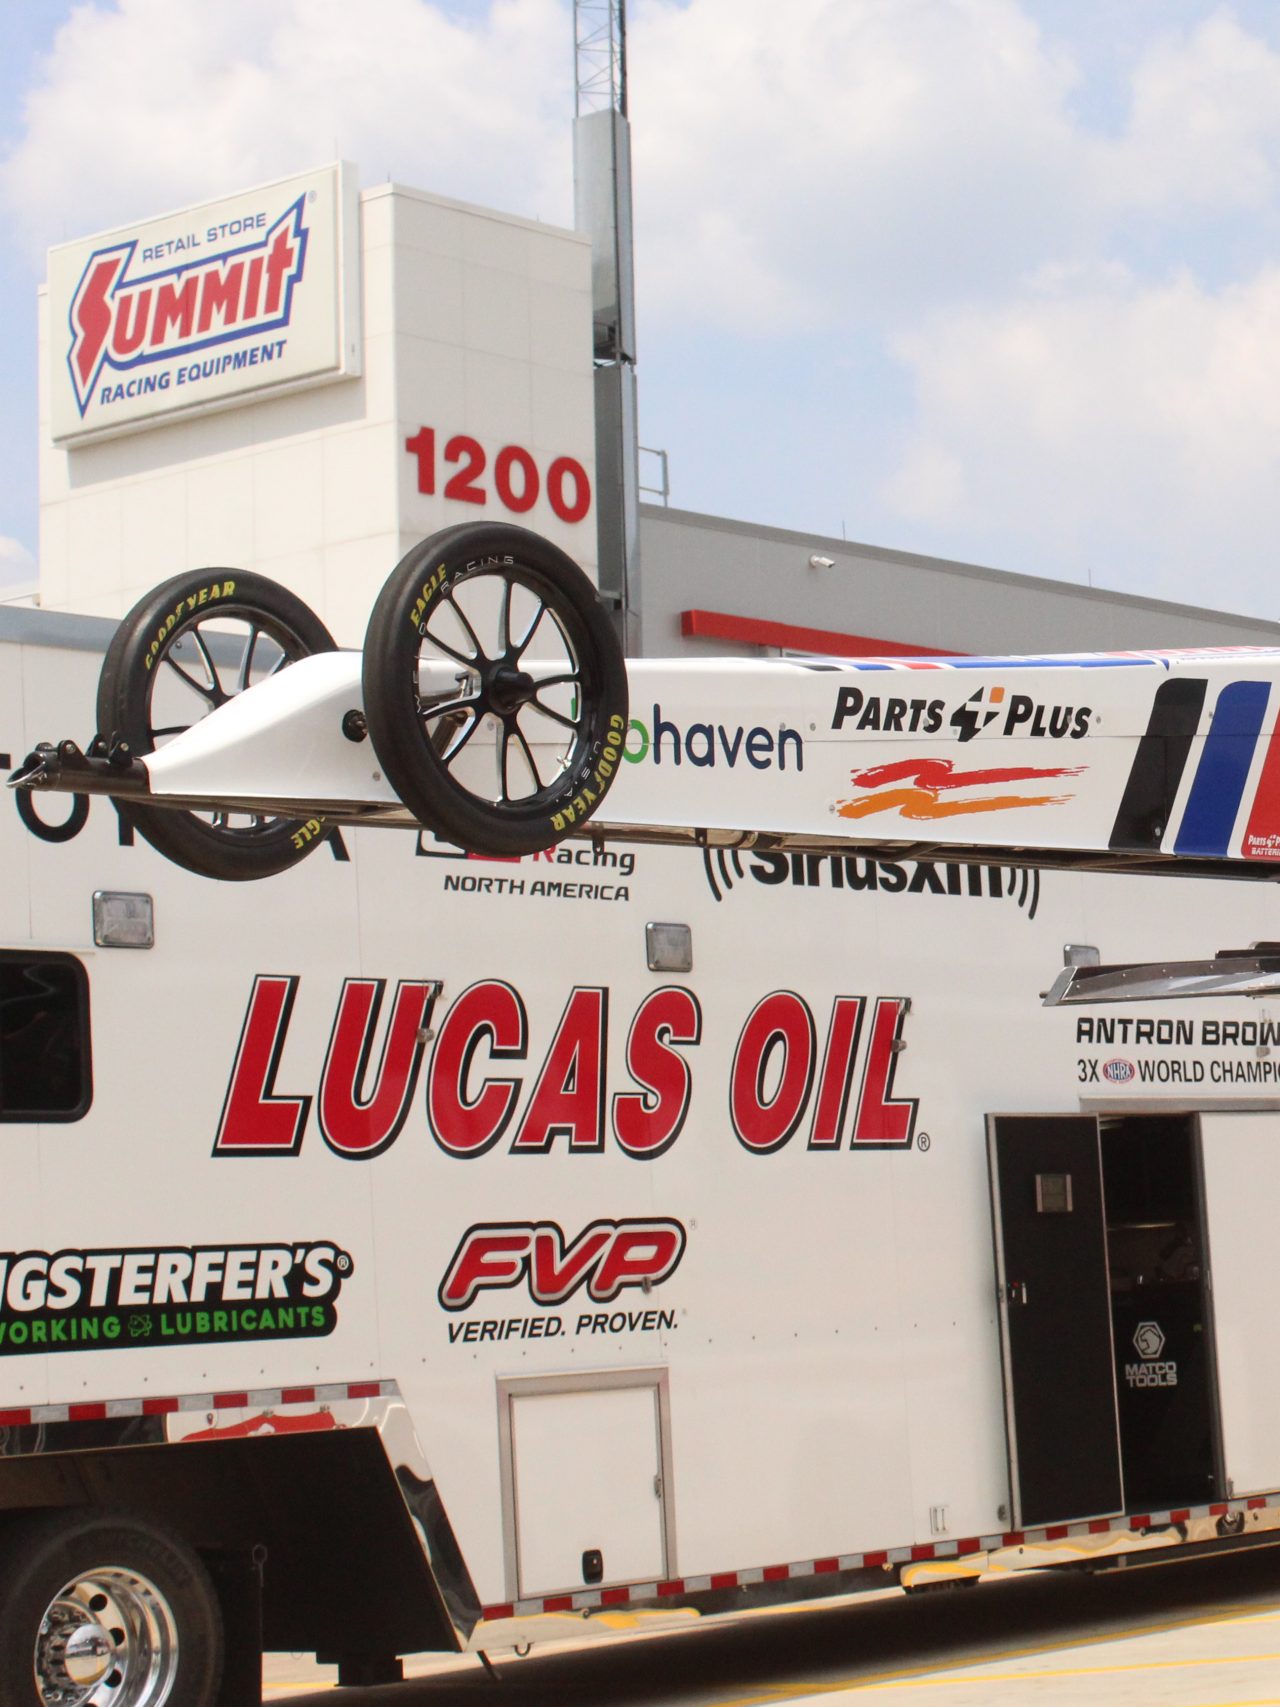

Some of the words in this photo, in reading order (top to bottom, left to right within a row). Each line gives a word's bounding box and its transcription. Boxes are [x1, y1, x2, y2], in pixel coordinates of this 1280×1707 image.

[142, 234, 201, 263] RETAIL
[206, 212, 267, 243] STORE
[76, 224, 295, 388] SUMMIT
[100, 371, 171, 405] RACING
[176, 339, 288, 386] EQUIPMENT
[405, 426, 592, 524] 1200
[410, 562, 448, 627] EAGLE
[145, 580, 236, 671] GOODYEAR
[621, 703, 804, 772] ohaven
[831, 686, 945, 733] PARTS
[1002, 694, 1092, 740] PLUS
[550, 714, 625, 831] GOODYEAR
[1248, 834, 1267, 847] PARTS
[444, 874, 525, 896] NORTH
[530, 880, 630, 901] AMERICA
[1076, 1017, 1194, 1046] ANTRON
[211, 973, 701, 1161] LUCAS
[730, 989, 920, 1155] OIL
[1077, 1058, 1101, 1083] 3X
[1104, 1060, 1135, 1083] NHRA
[1137, 1059, 1205, 1084] WORLD
[0, 1246, 336, 1313] GSTERFER'S
[440, 1221, 684, 1307] FVP
[0, 1315, 122, 1346] ORKING
[160, 1304, 326, 1336] LUBRICANTS
[447, 1315, 566, 1344] VERIFIED.
[575, 1309, 679, 1336] PROVEN.
[1124, 1361, 1177, 1376] MATCO
[1125, 1373, 1178, 1388] TOOLS
